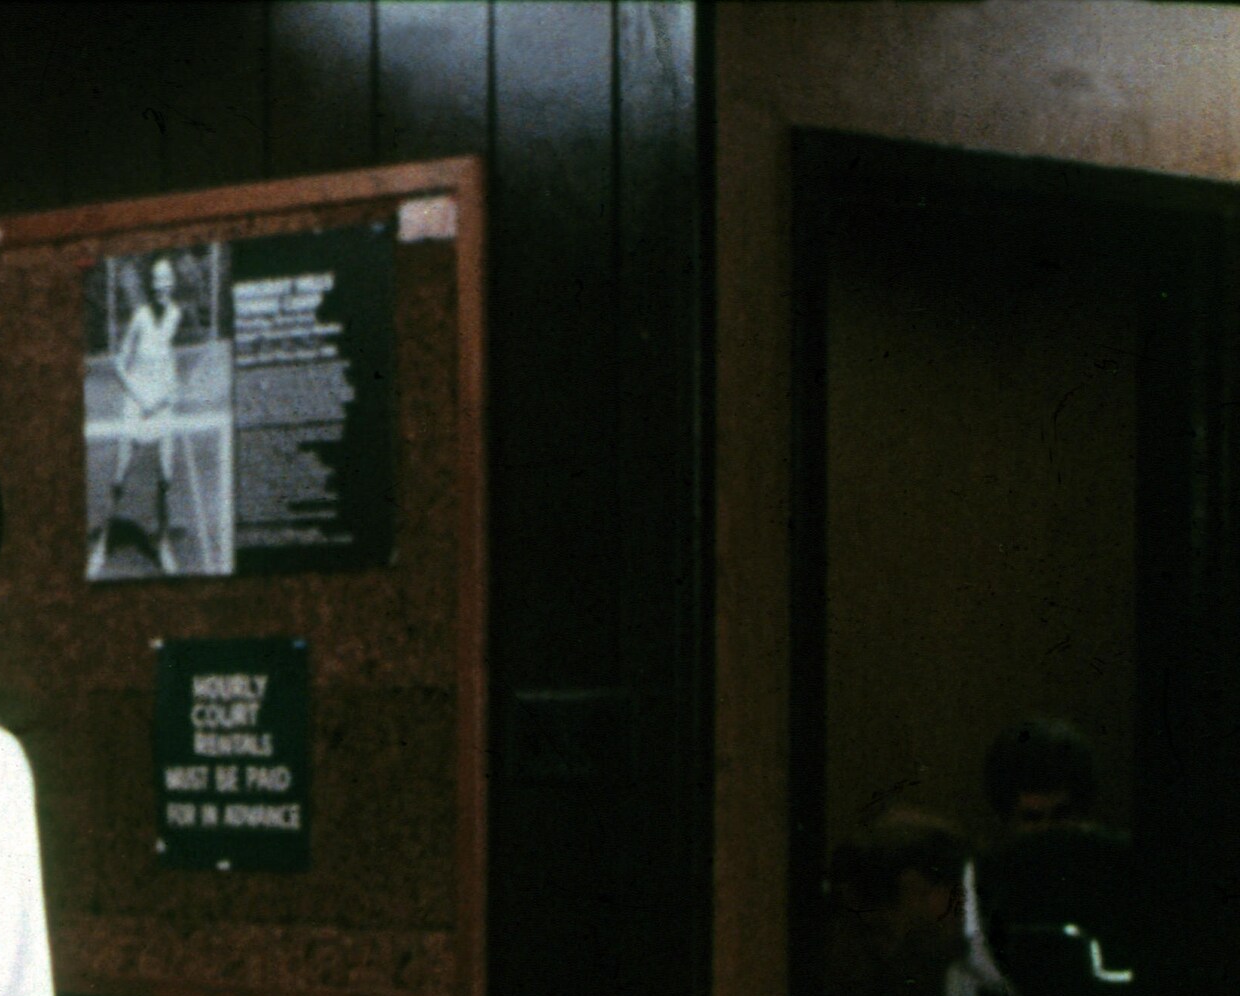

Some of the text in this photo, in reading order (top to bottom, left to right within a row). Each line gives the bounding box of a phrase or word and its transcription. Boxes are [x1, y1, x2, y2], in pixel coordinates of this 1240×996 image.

[192, 673, 268, 699] HOURLY
[190, 701, 260, 728] COURT
[193, 732, 274, 757] RENTALS
[245, 766, 293, 791] PAID
[224, 804, 300, 829] ADVANCE
